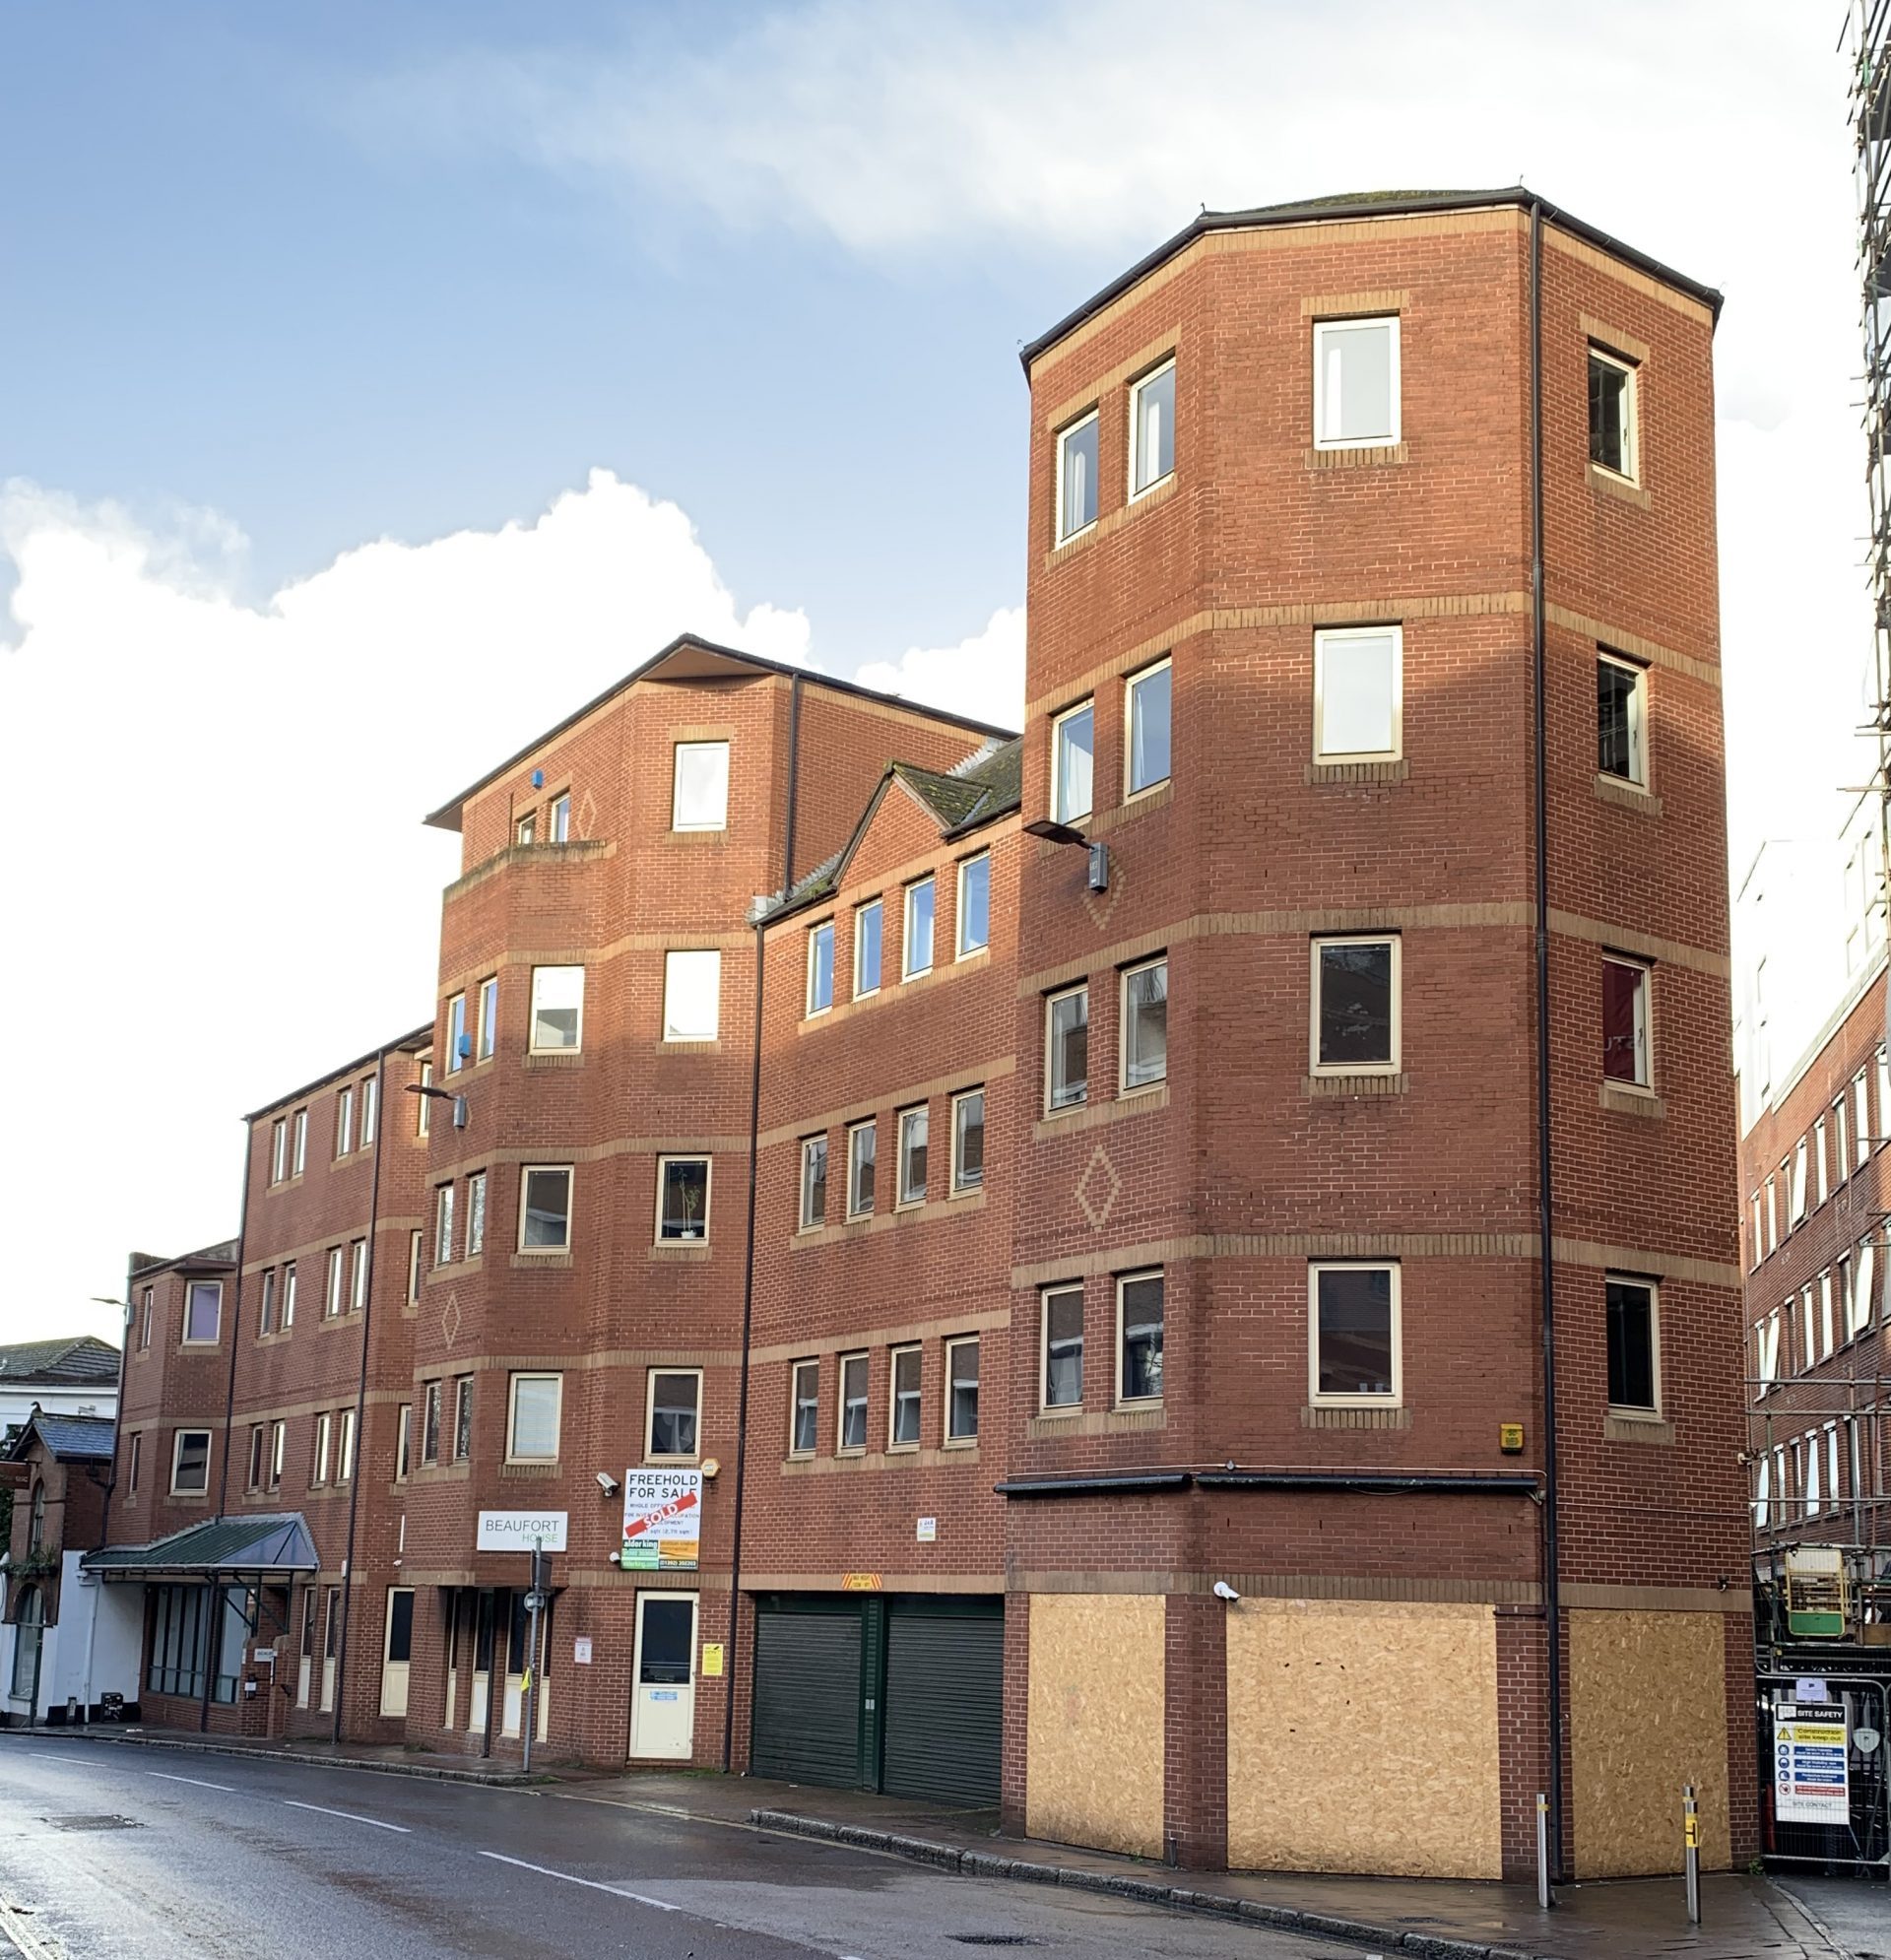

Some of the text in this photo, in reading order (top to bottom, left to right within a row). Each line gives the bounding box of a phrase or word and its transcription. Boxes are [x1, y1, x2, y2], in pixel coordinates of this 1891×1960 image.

[629, 1474, 698, 1485] FREEHOLD
[629, 1488, 655, 1498] FOR
[643, 1504, 679, 1529] SOLD
[486, 1520, 559, 1532] BEAUFORT
[623, 1538, 642, 1547] alder
[642, 1538, 658, 1549] king
